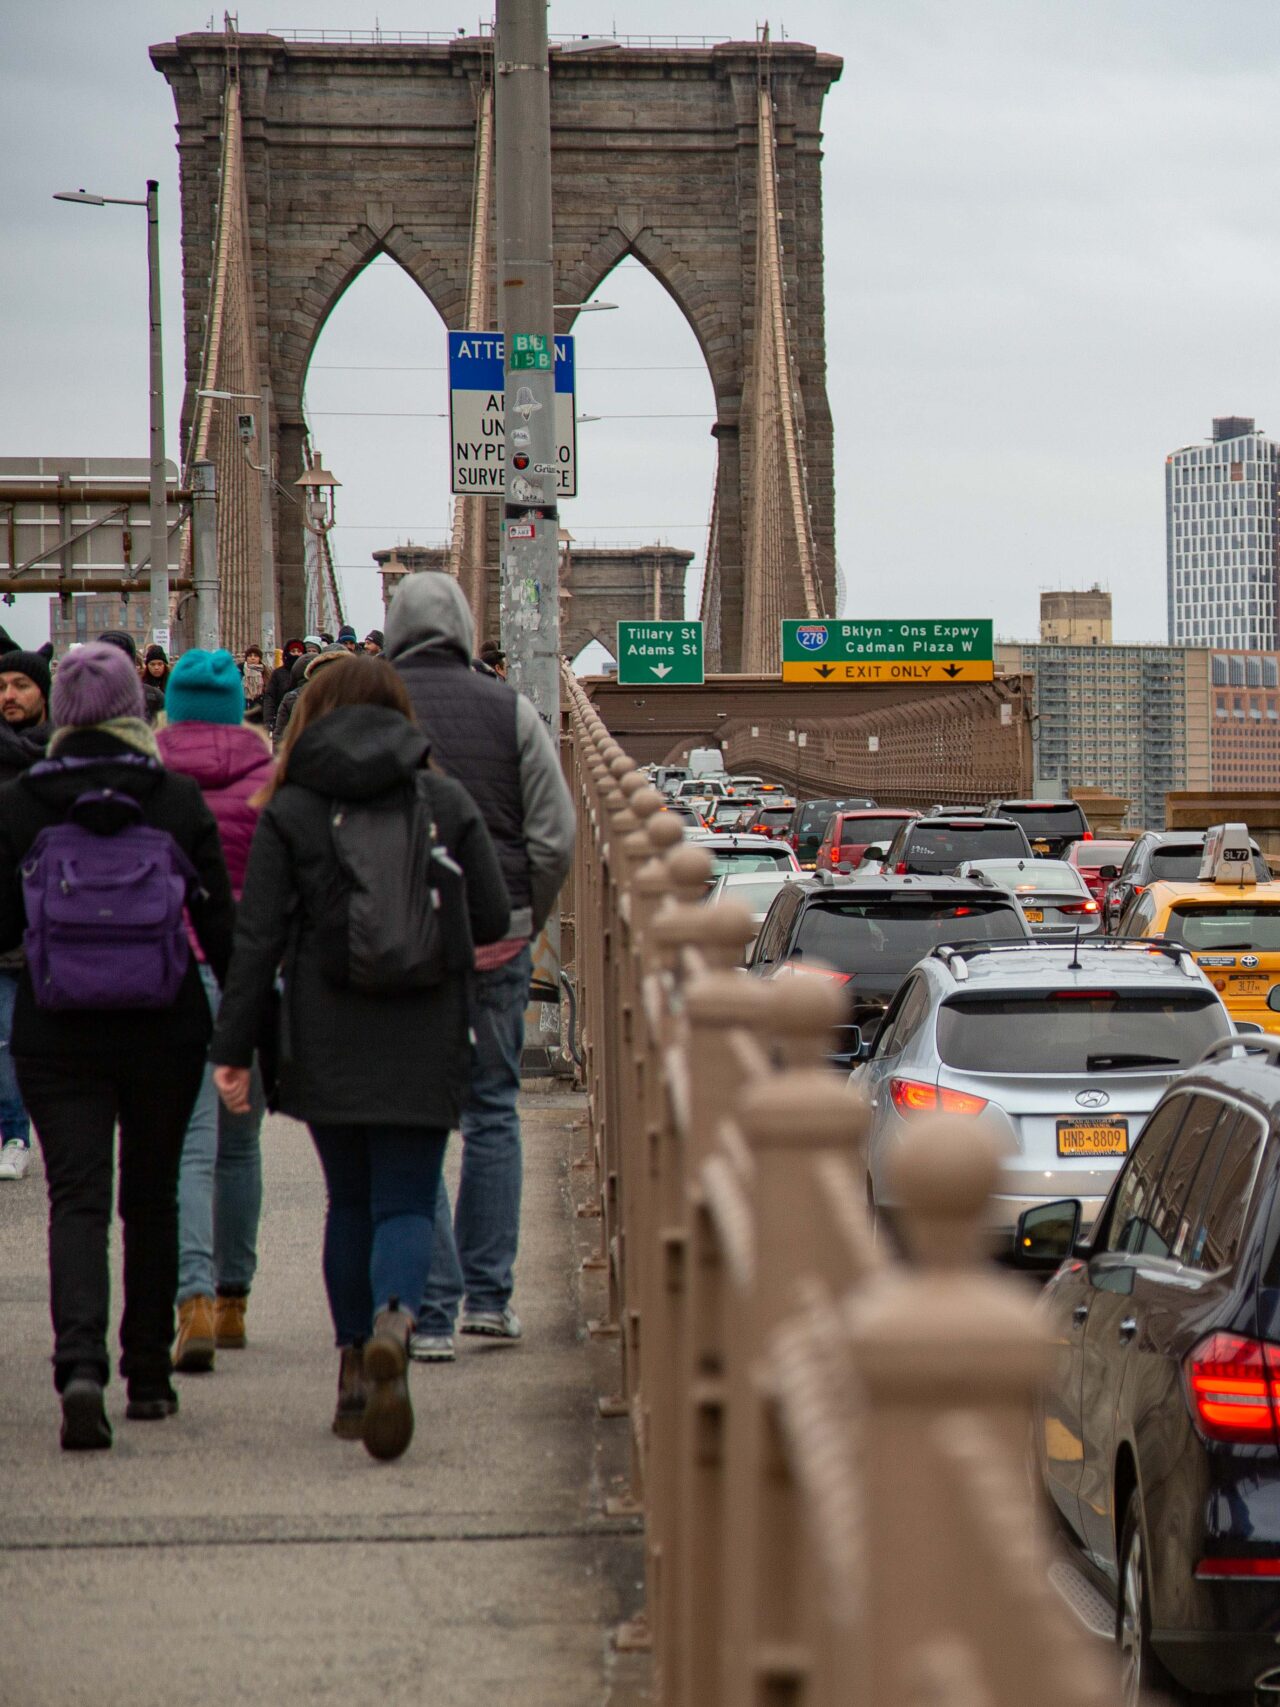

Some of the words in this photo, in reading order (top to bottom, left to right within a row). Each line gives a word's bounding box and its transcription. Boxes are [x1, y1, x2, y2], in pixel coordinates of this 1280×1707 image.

[458, 341, 566, 362] ATTEN
[627, 628, 673, 642] Tillary
[681, 628, 696, 639] St
[842, 625, 881, 638] Bklyn
[900, 625, 927, 636] Qns
[934, 625, 979, 638] Expwy
[802, 633, 824, 645] 278
[627, 644, 675, 655] Adams
[682, 644, 697, 655] St
[845, 642, 905, 652] Cadman
[913, 641, 954, 652] Plaza
[962, 641, 973, 652] W
[845, 666, 882, 678] EXIT
[891, 665, 932, 677] ONLY
[1224, 850, 1247, 859] 3L77
